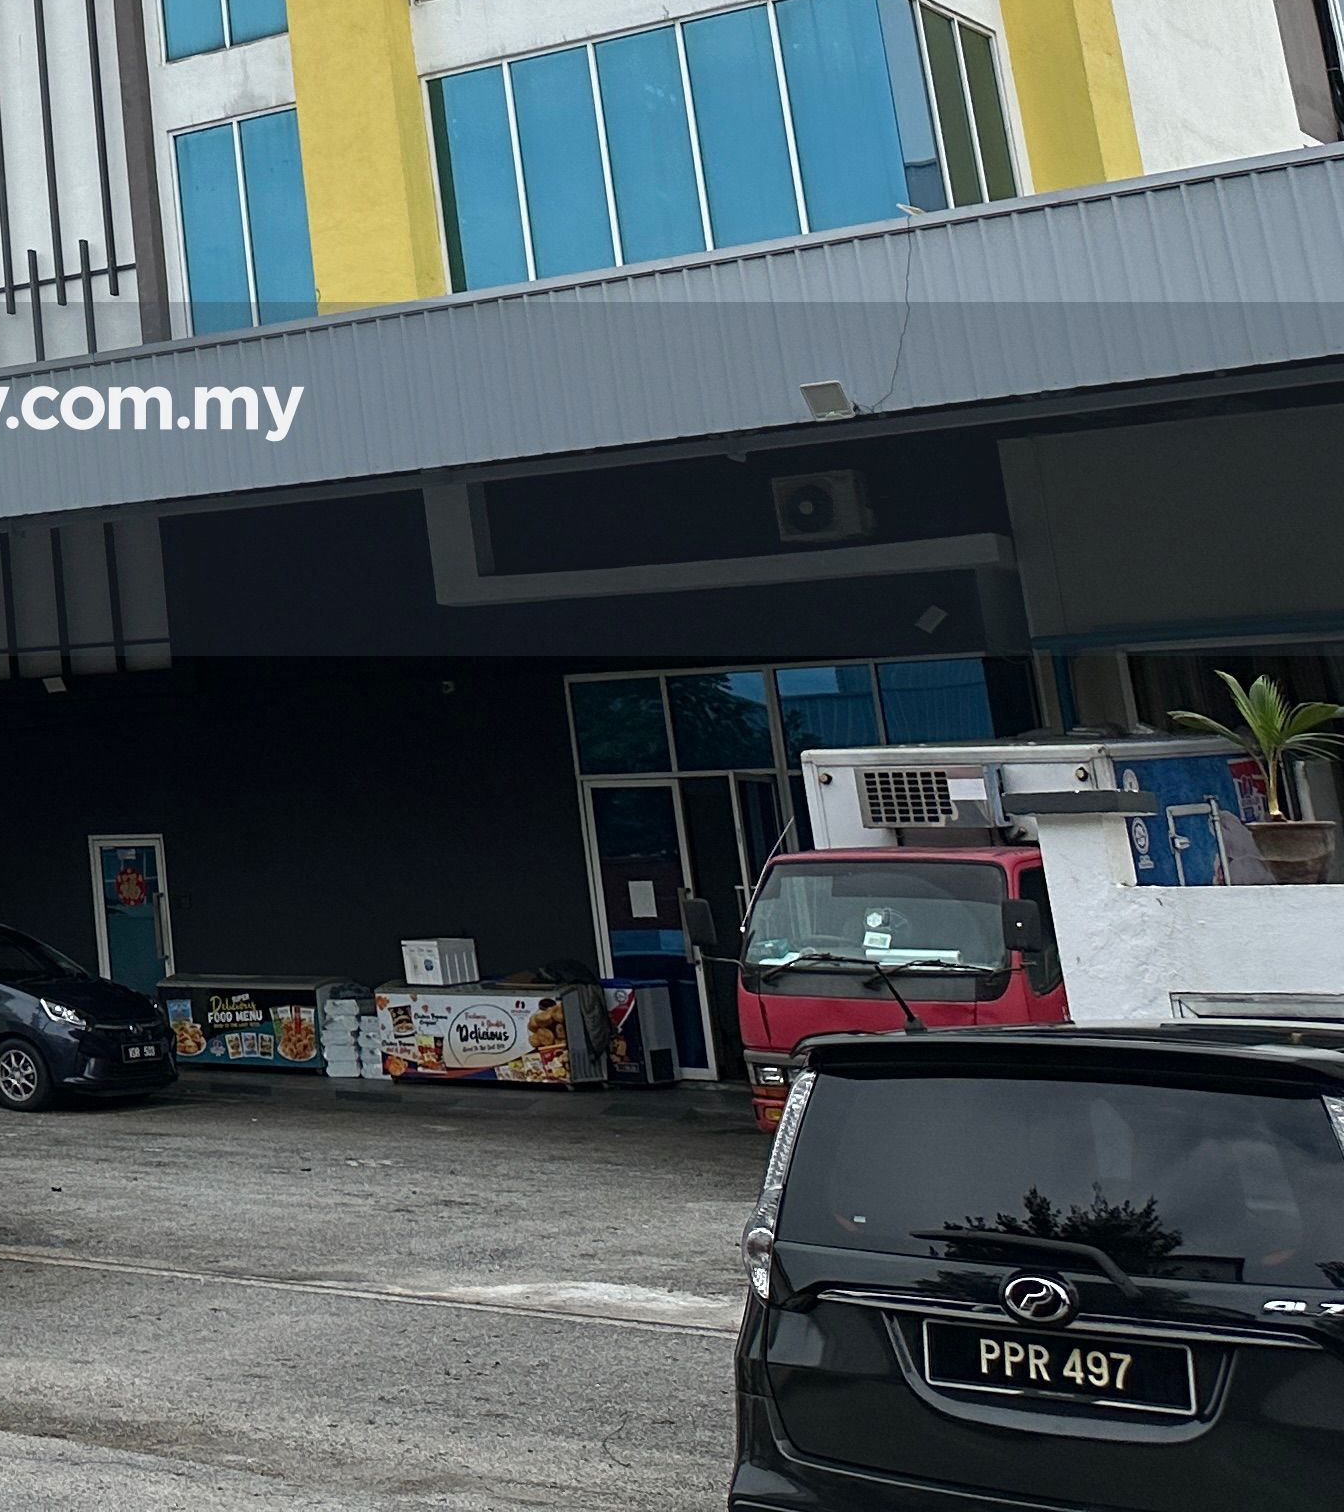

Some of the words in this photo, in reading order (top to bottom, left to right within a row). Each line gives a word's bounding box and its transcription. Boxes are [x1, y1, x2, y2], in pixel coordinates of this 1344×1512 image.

[207, 1011, 233, 1024] FOOD
[235, 1009, 263, 1022] MENU
[456, 1023, 510, 1044] Delicious
[979, 1338, 1052, 1382] PPR
[1062, 1347, 1133, 1390] 497
